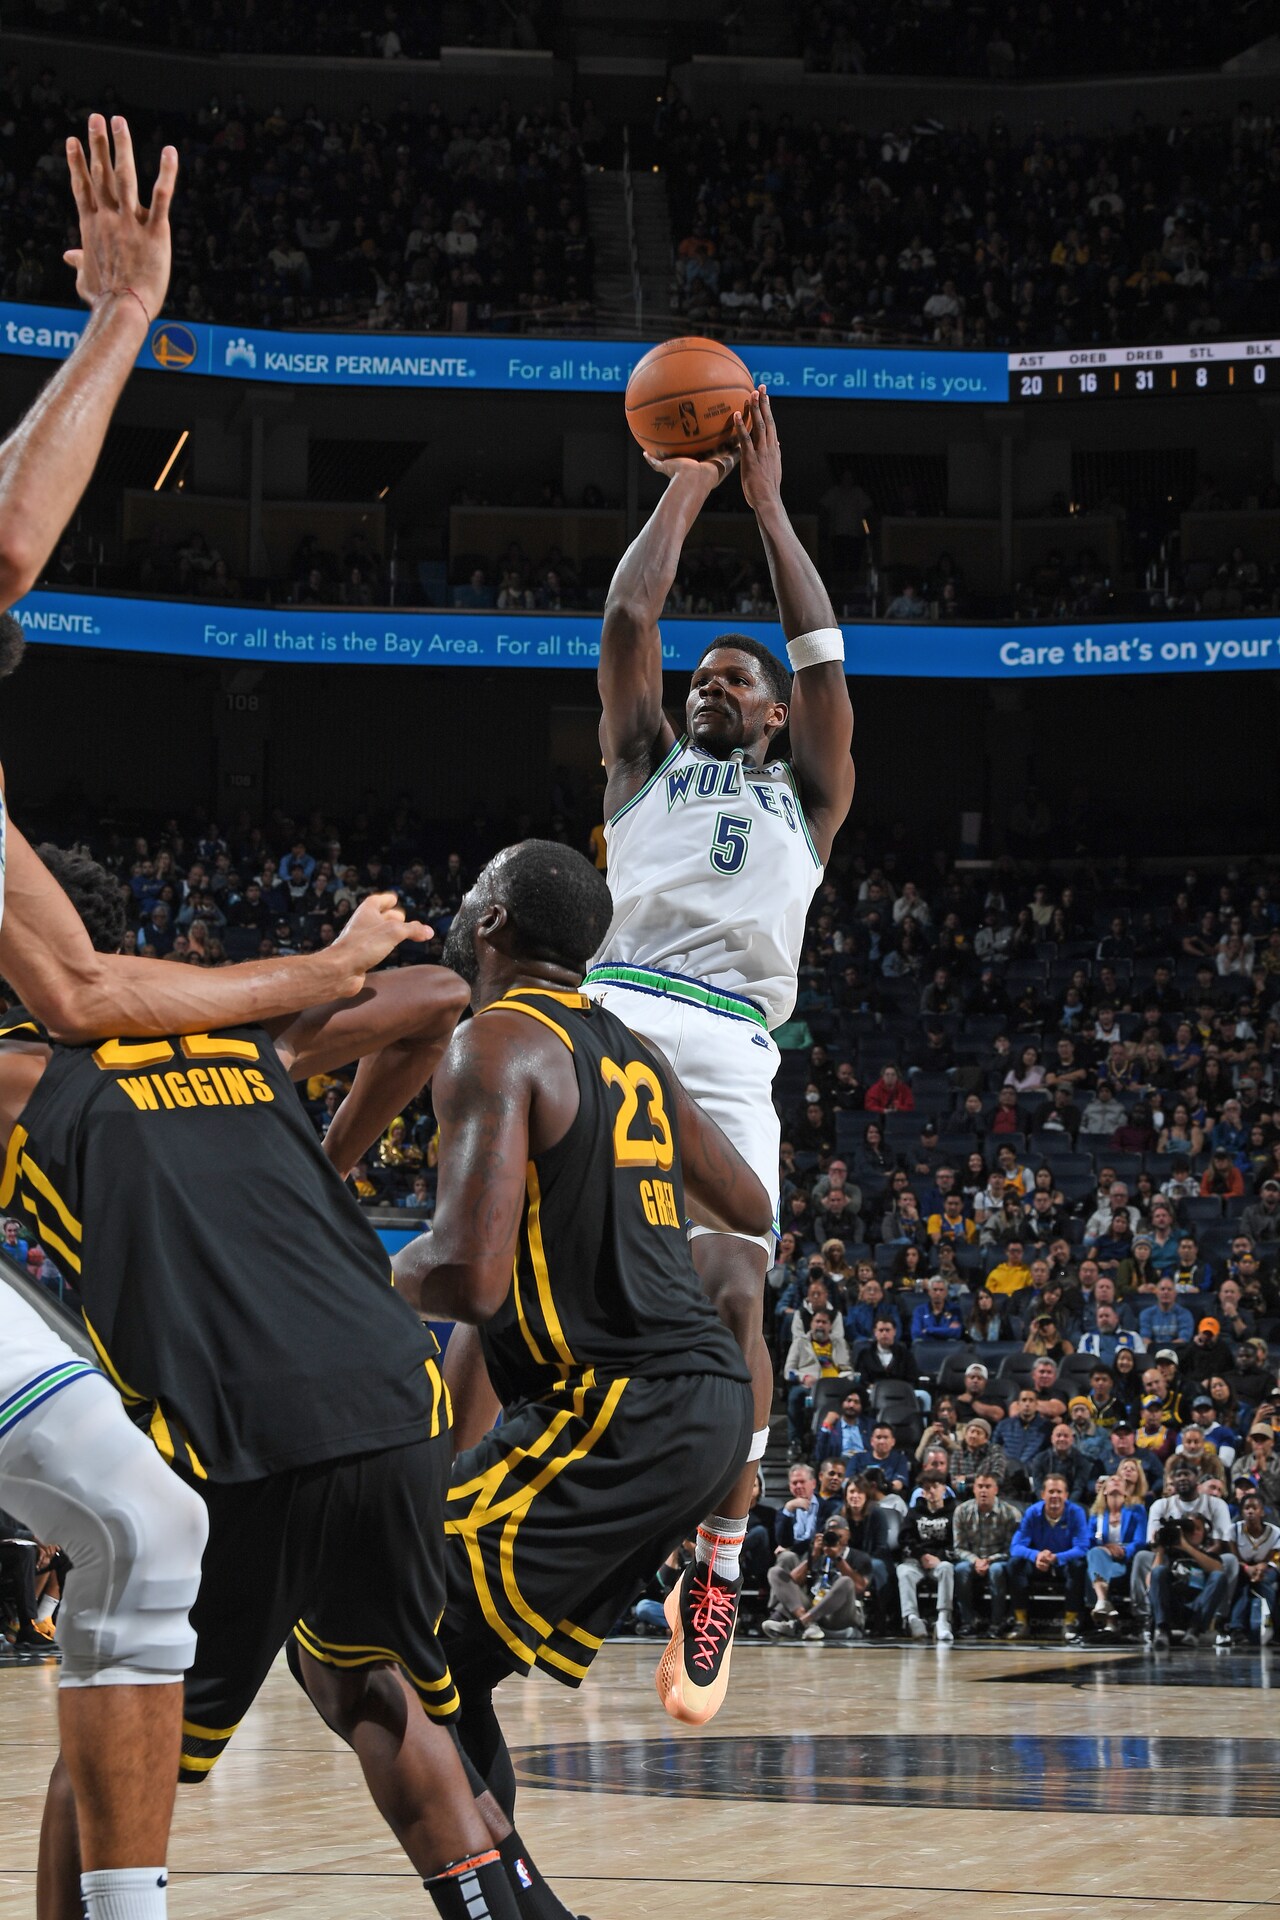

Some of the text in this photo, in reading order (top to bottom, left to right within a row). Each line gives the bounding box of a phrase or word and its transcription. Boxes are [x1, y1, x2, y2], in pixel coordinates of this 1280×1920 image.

[5, 320, 79, 348] team
[264, 352, 329, 373] KAISER
[1018, 344, 1273, 367] AST OREB DREB STL BLK
[508, 359, 543, 379] For
[549, 360, 573, 380] all
[580, 361, 620, 381] that
[751, 371, 791, 387] rea.
[803, 367, 837, 387] For
[843, 369, 867, 388] all
[873, 370, 914, 390] that
[920, 371, 937, 391] is
[942, 377, 987, 397] you.
[1020, 364, 1266, 396] 20 16 31 8 0
[204, 624, 681, 658] For all that is the Bay Area. For all tha u.
[999, 641, 1065, 666] Care
[1072, 637, 1153, 664] that's
[1160, 641, 1198, 661] on
[1204, 639, 1273, 666] your
[665, 760, 798, 833] WOLES
[709, 811, 752, 876] 5
[116, 1066, 276, 1111] WIGGINS
[600, 1056, 674, 1172] 23
